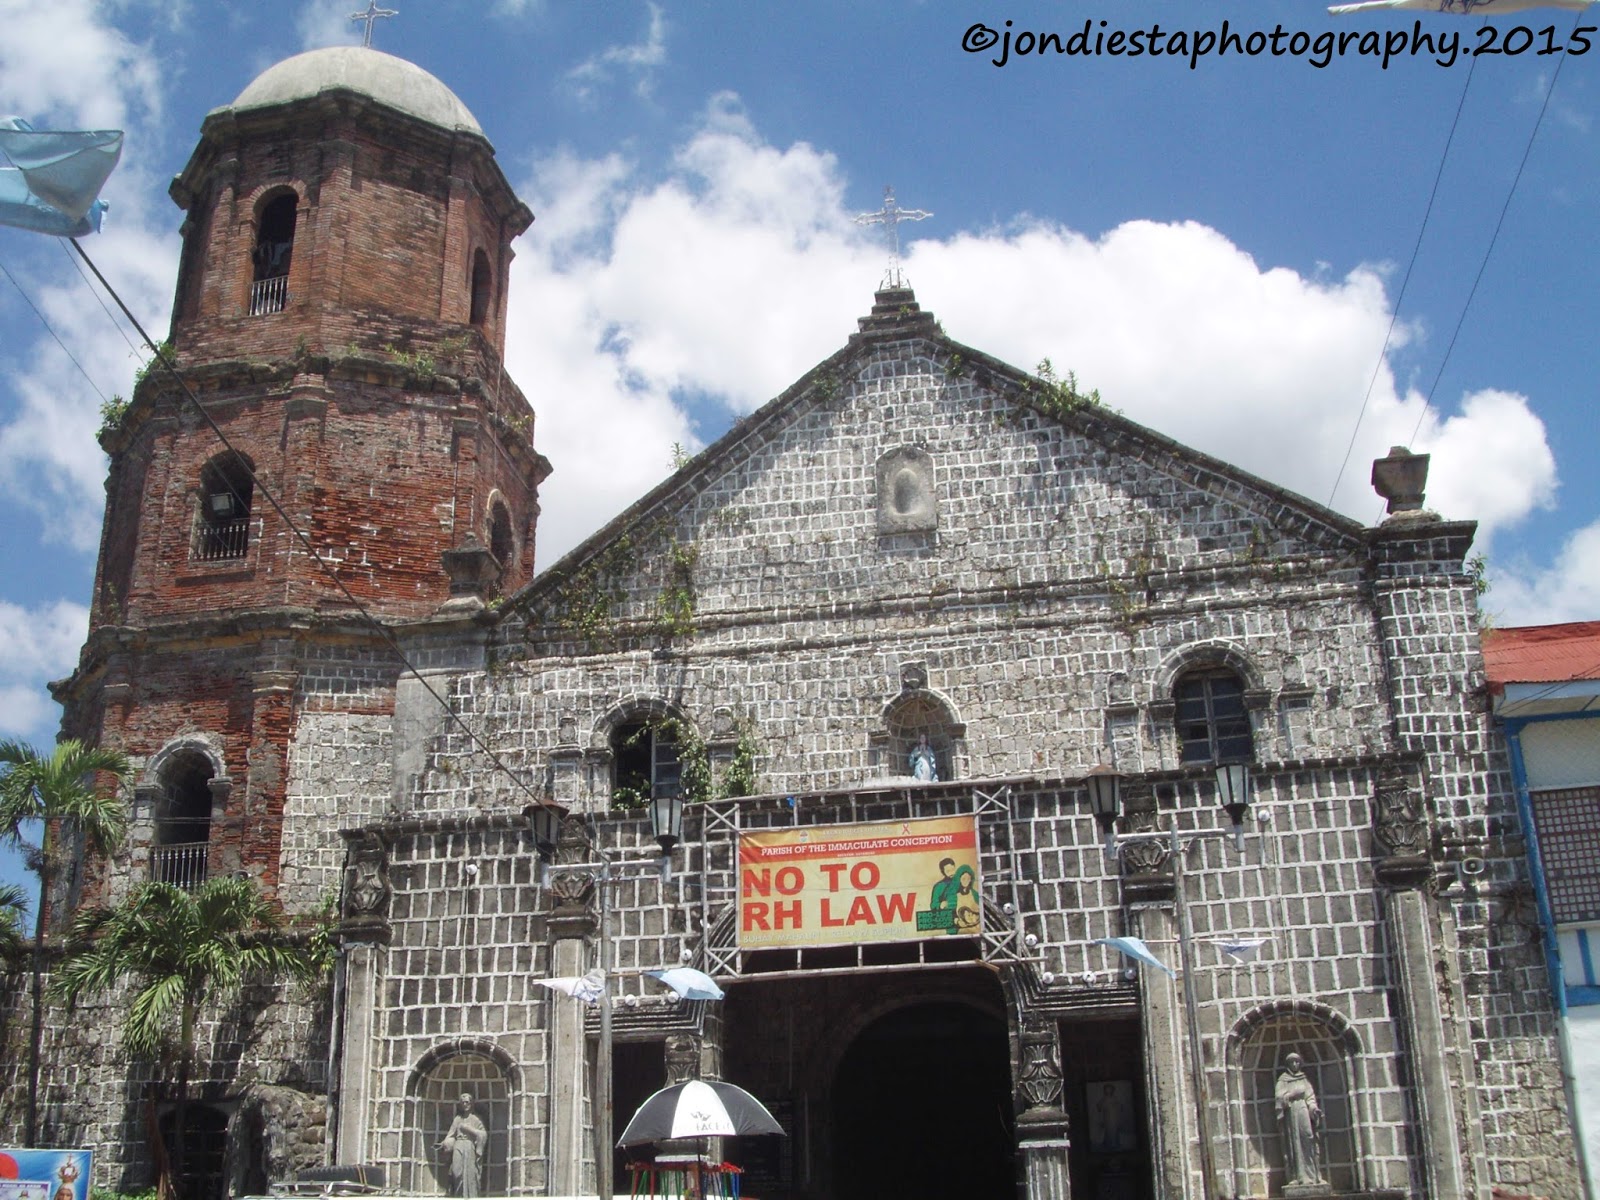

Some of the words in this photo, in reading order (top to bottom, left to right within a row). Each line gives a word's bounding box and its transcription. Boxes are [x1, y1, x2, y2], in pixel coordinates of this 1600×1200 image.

[761, 845, 793, 856] PARISH
[795, 843, 808, 854] OF
[809, 842, 827, 853] THE
[828, 839, 889, 852] IMMACULATE
[890, 835, 952, 848] CONCEPTION
[743, 866, 805, 898] NO
[820, 861, 880, 893] TO
[743, 900, 802, 931] RH
[820, 893, 917, 927] LAW
